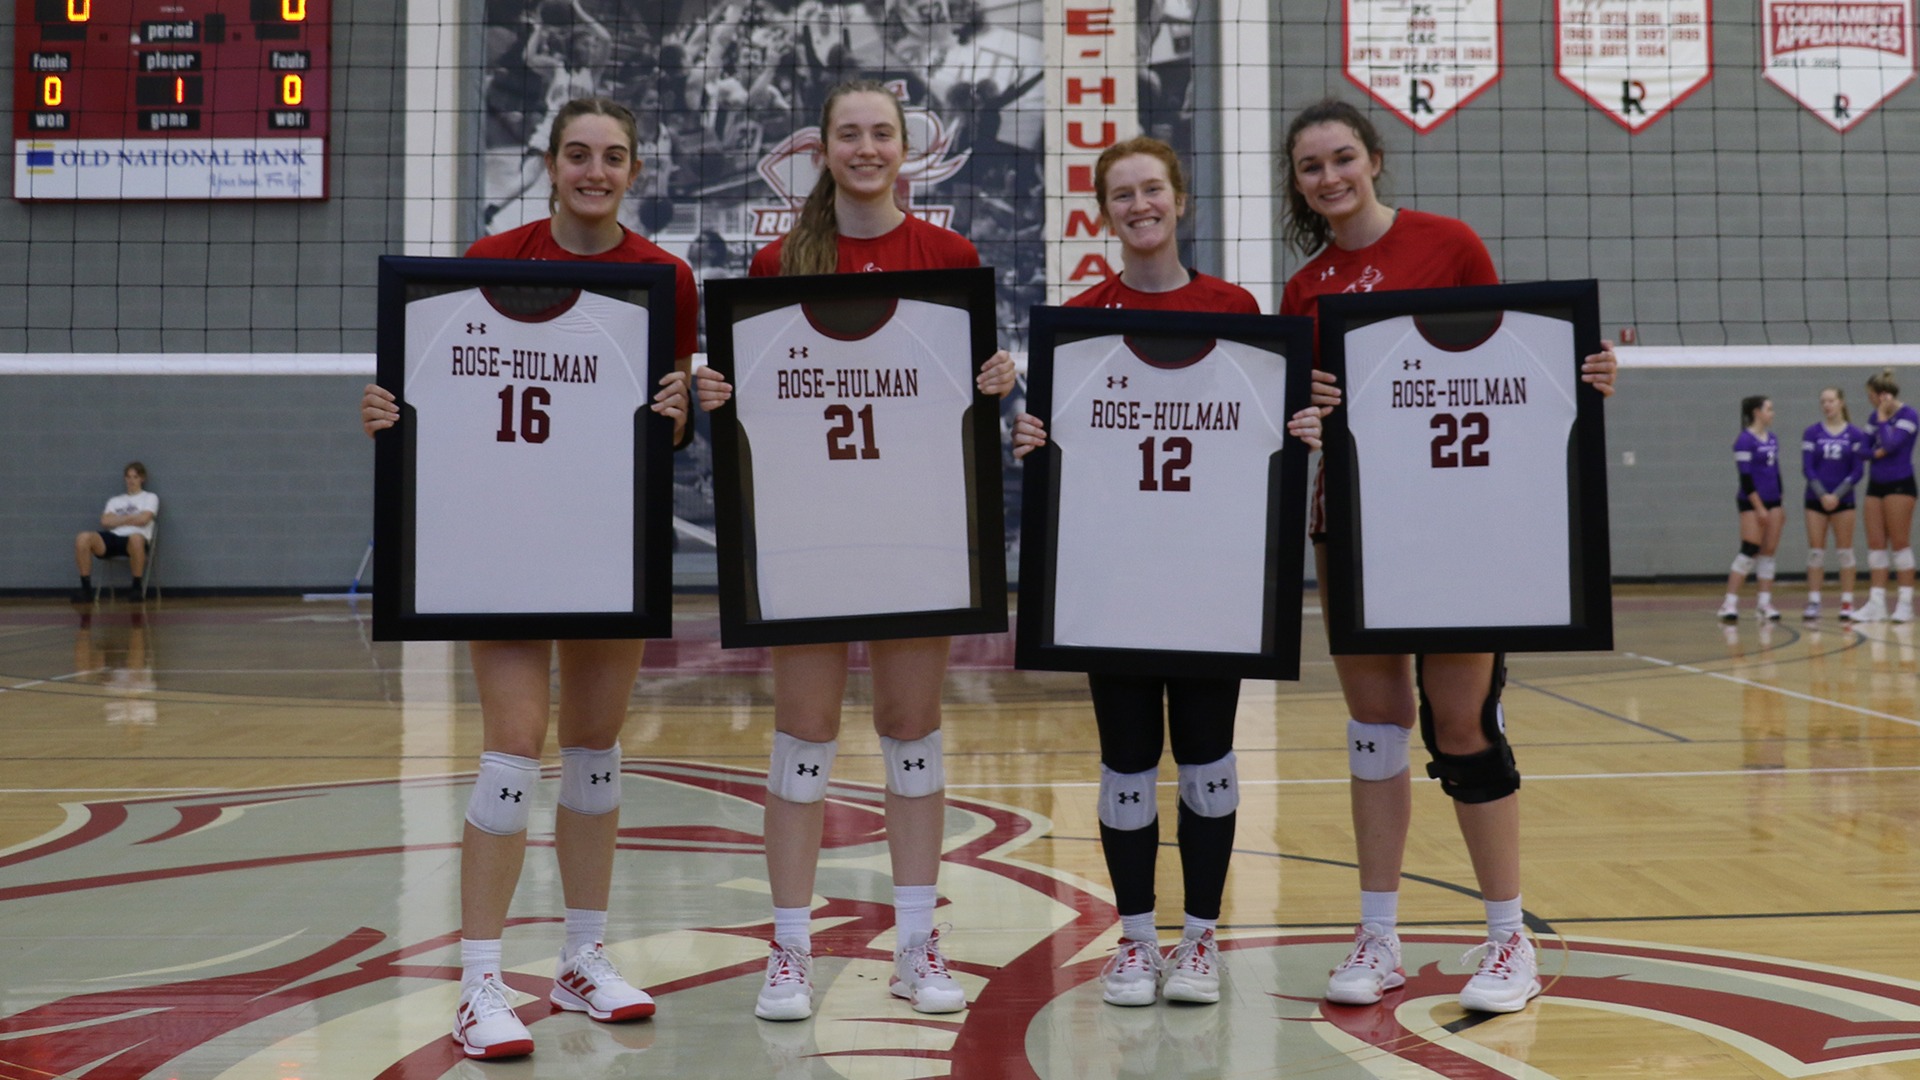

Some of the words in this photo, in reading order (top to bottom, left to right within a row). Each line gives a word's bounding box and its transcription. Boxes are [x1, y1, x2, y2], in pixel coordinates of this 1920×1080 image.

[1773, 6, 1901, 24] TOURNAMENT
[147, 21, 194, 41] period
[1775, 26, 1901, 50] APPEARANCES
[33, 54, 68, 69] fouls
[146, 53, 195, 71] player
[272, 52, 306, 69] fouls
[44, 76, 62, 106] 0
[176, 76, 184, 104] 1
[283, 74, 302, 105] 0
[35, 113, 65, 128] won
[151, 113, 188, 130] game
[274, 112, 305, 127] won
[60, 149, 110, 167] OLD
[117, 149, 236, 167] NATIONAL
[242, 149, 306, 167] BANK
[452, 346, 598, 383] ROSE-HULMAN
[778, 368, 918, 399] ROSE-HULMAN
[1392, 377, 1527, 408] ROSE-HULMAN
[496, 384, 551, 444] 16
[1091, 399, 1241, 431] ROSE-HULMAN
[824, 404, 880, 460] 21
[1430, 412, 1489, 468] 22
[1823, 443, 1841, 458] 12
[1138, 436, 1193, 492] 12
